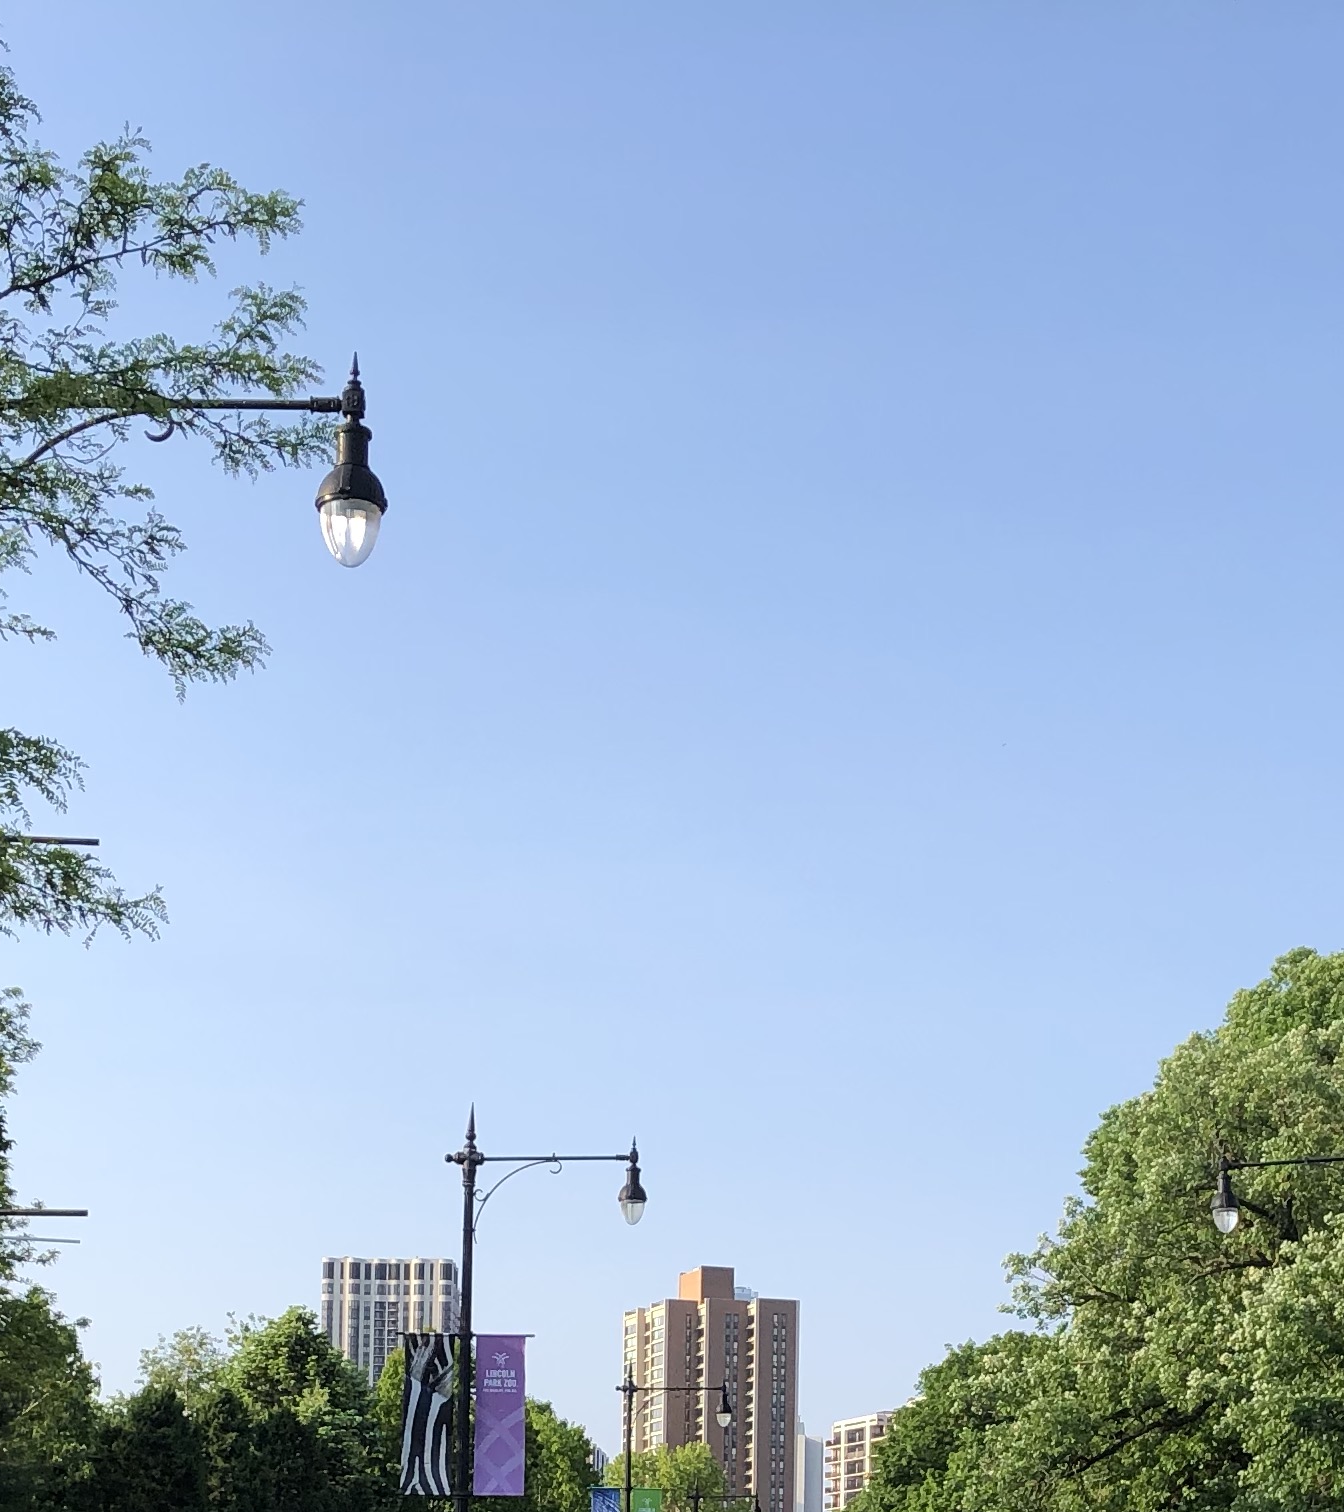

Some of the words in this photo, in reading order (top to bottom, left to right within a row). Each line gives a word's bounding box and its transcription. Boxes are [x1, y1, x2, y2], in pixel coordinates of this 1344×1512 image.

[485, 1369, 516, 1378] LINCOLN
[483, 1378, 502, 1387] PARK
[503, 1378, 518, 1388] ZOO
